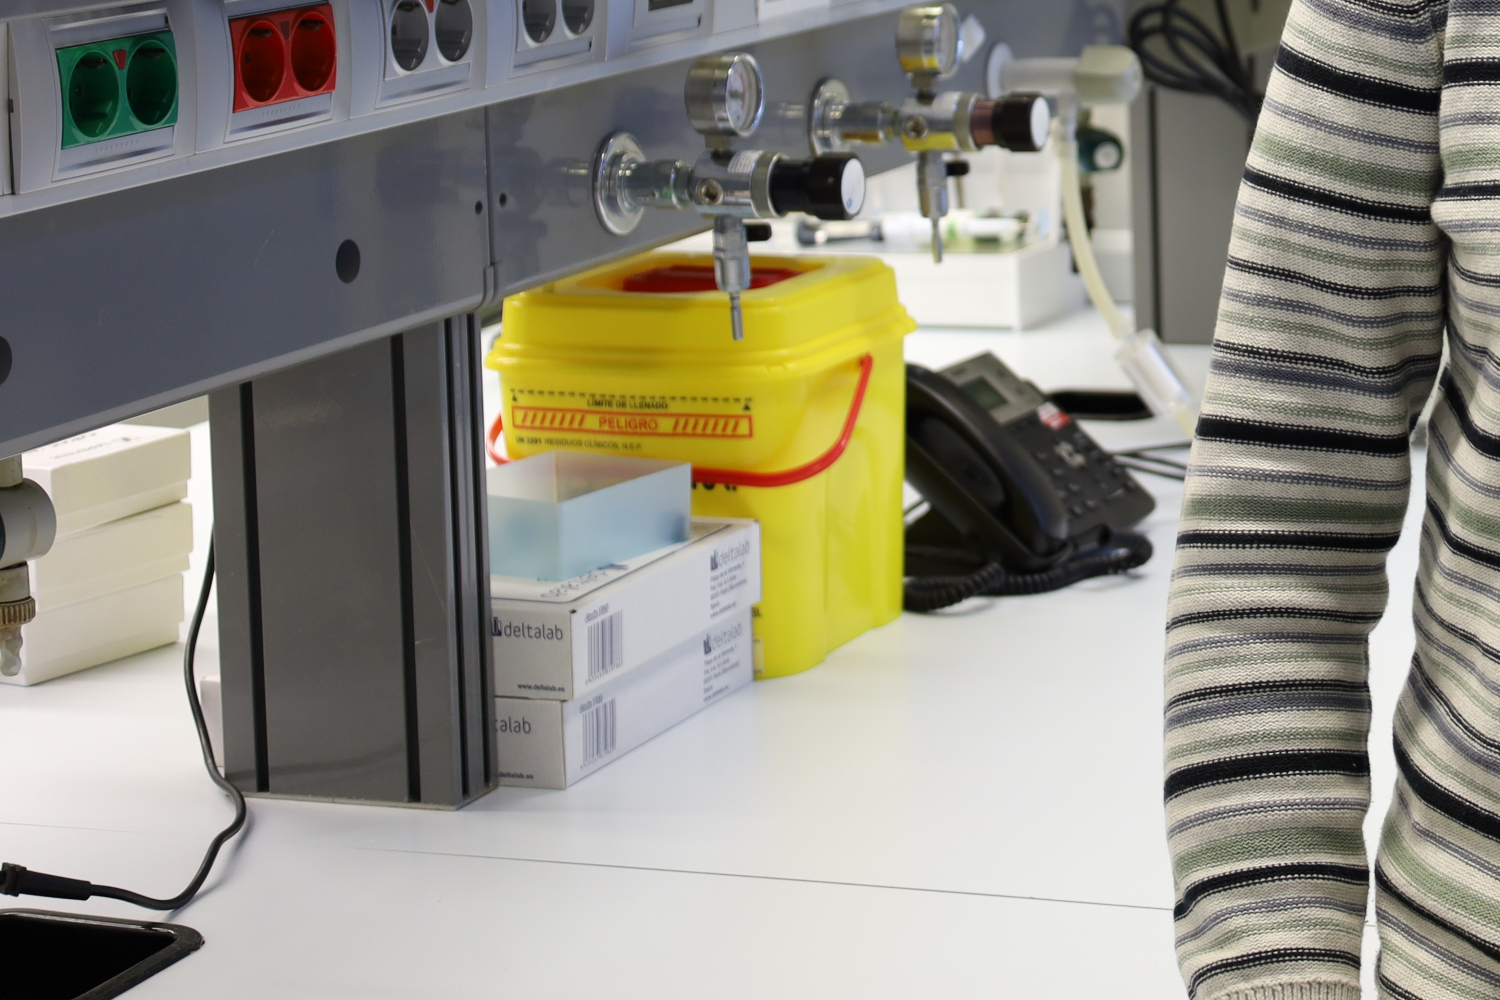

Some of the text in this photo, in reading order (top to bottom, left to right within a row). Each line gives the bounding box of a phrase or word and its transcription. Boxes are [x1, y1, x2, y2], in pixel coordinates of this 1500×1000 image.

[615, 399, 627, 409] DE
[629, 400, 669, 410] LLENADO
[598, 416, 659, 431] PELIGRO
[545, 438, 583, 447] RESIDUOS
[718, 539, 750, 567] deltalab
[503, 620, 564, 640] deltalab
[517, 683, 565, 693] www.deltalab.es
